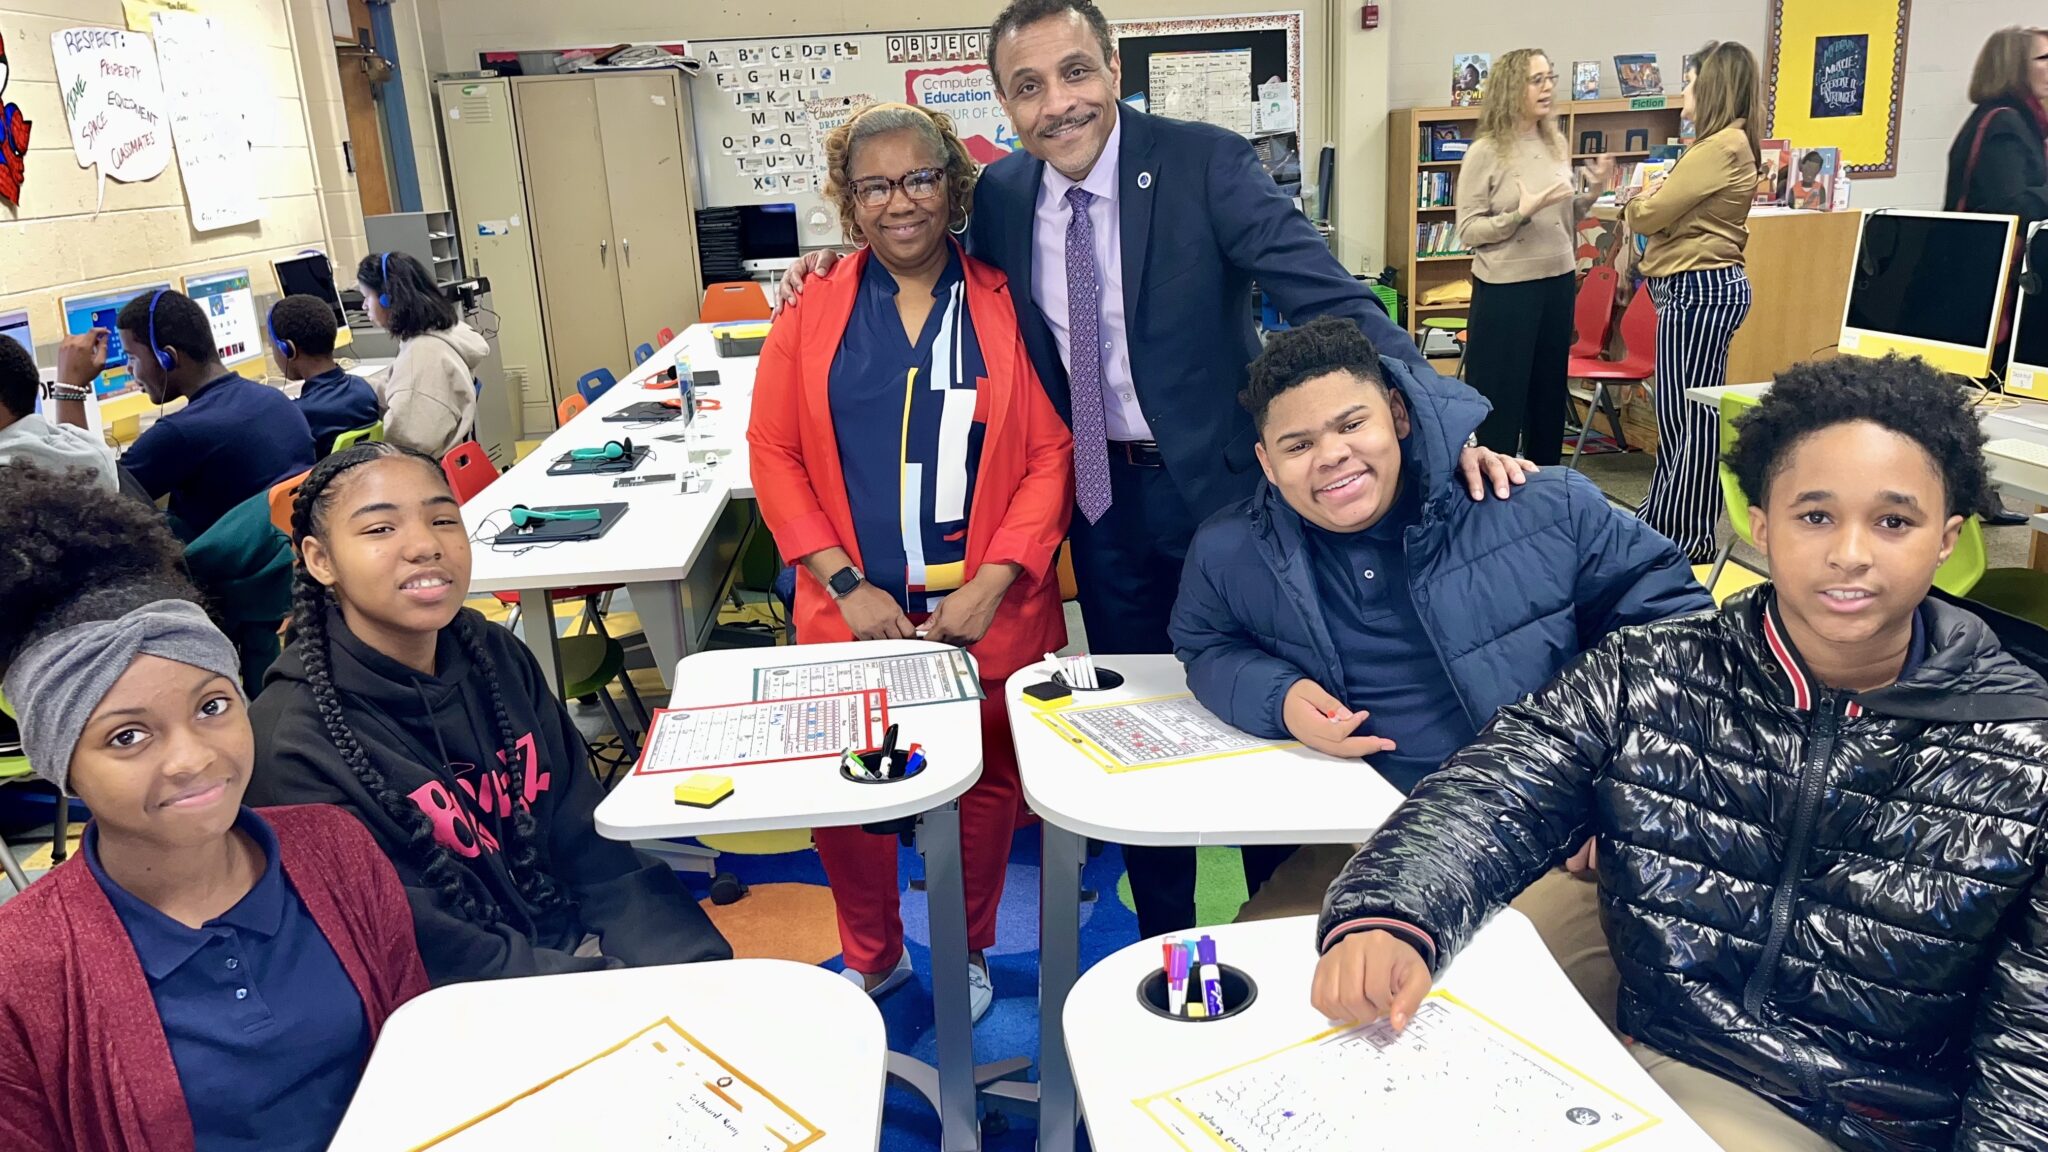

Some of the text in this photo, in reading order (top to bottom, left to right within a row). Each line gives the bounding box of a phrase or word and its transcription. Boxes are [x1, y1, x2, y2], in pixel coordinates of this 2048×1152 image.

[64, 31, 125, 55] RESPECT:
[891, 35, 990, 51] OBJEC
[708, 44, 841, 63] A B C D E
[716, 73, 724, 86] F
[748, 70, 758, 83] G
[780, 69, 790, 82] H
[811, 67, 815, 80] I
[923, 76, 982, 91] Computer
[736, 89, 805, 105] J K L
[924, 89, 991, 104] Education
[1632, 99, 1664, 108] Fiction
[752, 111, 795, 125] M N
[819, 119, 845, 130] DREA
[722, 133, 792, 149] O P Q
[737, 154, 805, 170] T U V
[753, 177, 763, 190] X
[781, 175, 790, 187] Y
